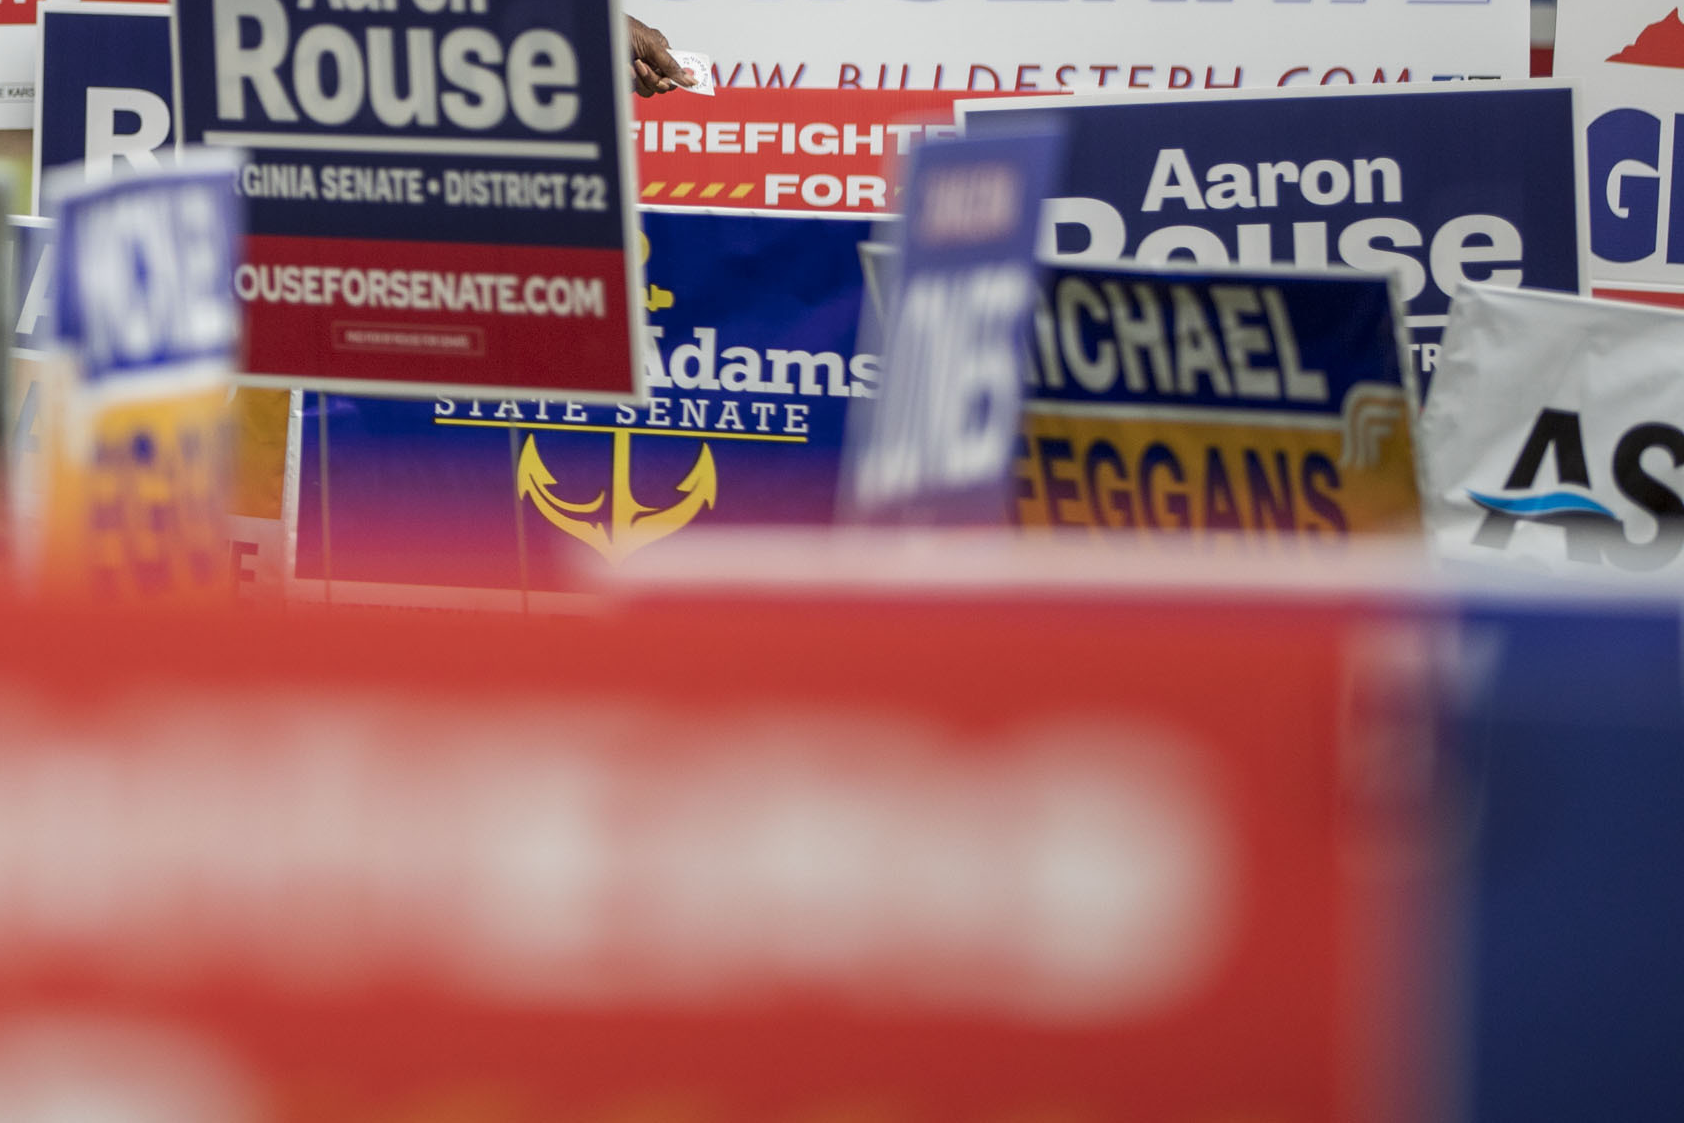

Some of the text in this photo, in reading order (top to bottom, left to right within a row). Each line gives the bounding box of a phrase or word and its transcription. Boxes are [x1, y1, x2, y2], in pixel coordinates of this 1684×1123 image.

[321, 167, 426, 203] SENATE
[444, 171, 566, 209] DISTRICT
[571, 175, 609, 212] 22
[765, 174, 888, 207] FOR
[1141, 147, 1403, 213] Aaron
[231, 264, 606, 319] OUSEFORSENATE.COM
[615, 396, 811, 434] SENATE
